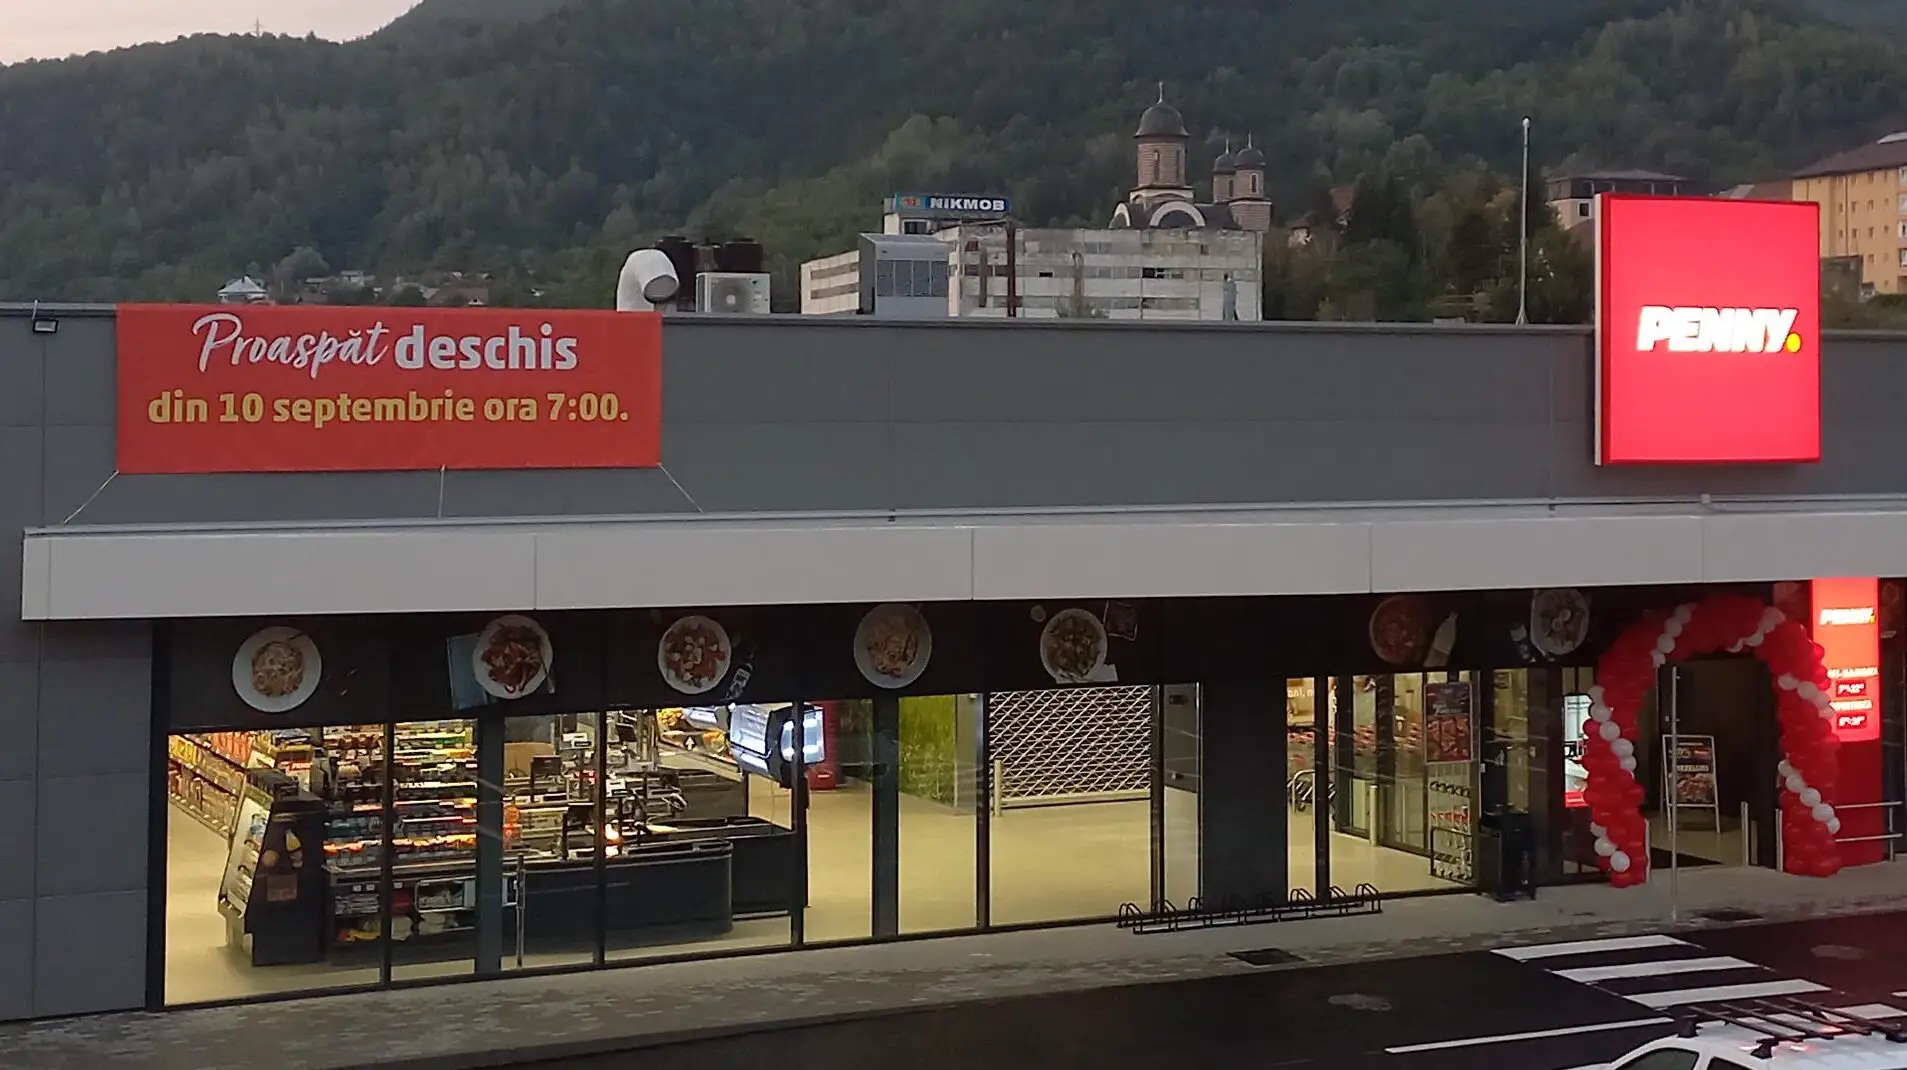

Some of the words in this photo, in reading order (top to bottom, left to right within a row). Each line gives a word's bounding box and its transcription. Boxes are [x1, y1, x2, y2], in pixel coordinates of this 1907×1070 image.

[931, 197, 1005, 211] NIKMOB
[192, 313, 389, 378] Proaspăt
[394, 323, 578, 370] deschis
[1635, 305, 1803, 353] PENNY.
[148, 390, 208, 423] din
[219, 393, 264, 422] 10
[272, 389, 475, 429] septembrie
[483, 398, 538, 421] ora
[546, 392, 629, 422] 7:00.
